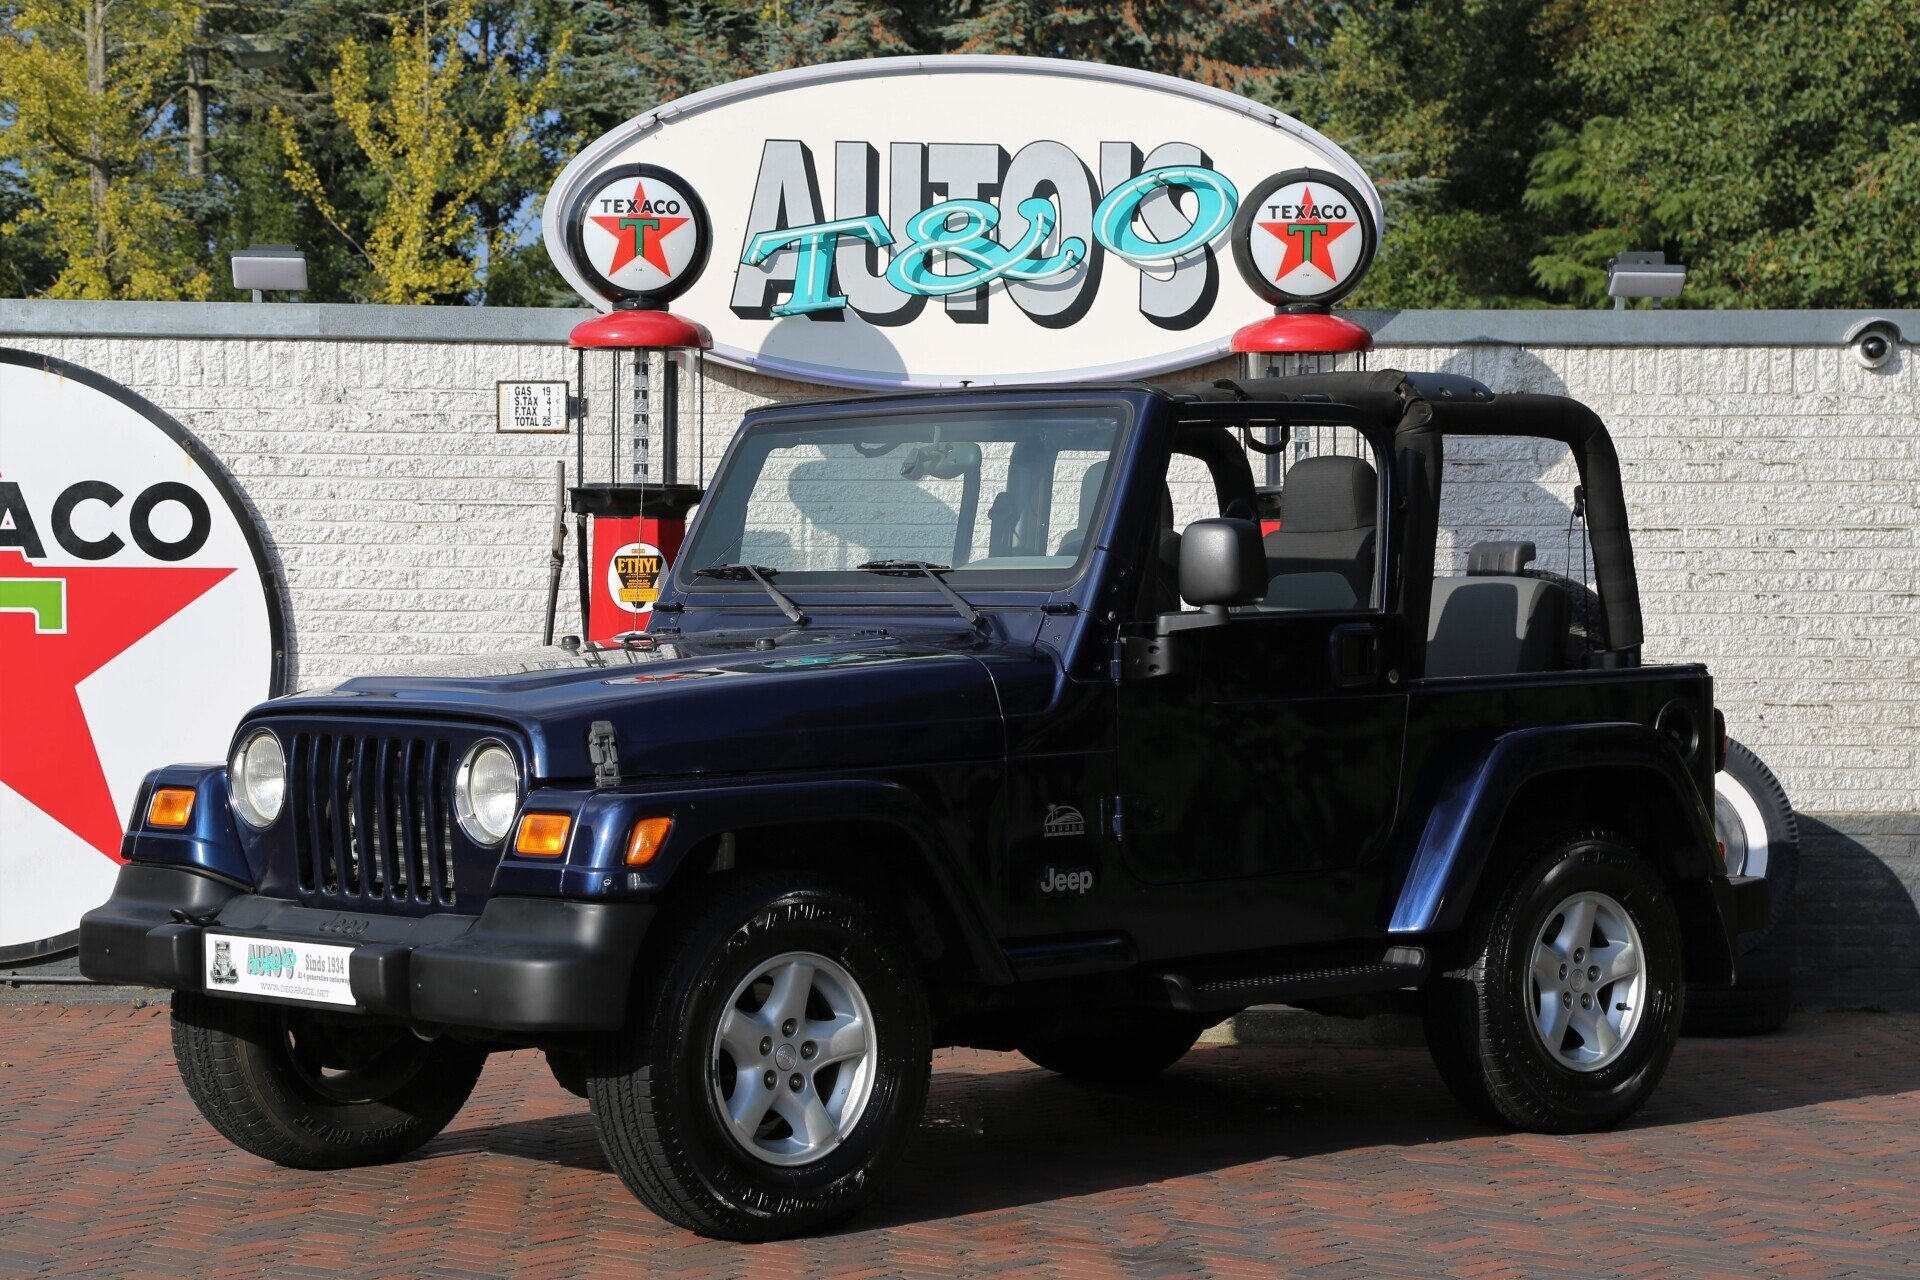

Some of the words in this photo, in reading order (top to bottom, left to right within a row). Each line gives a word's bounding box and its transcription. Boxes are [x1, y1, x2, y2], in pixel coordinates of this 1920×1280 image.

[600, 198, 681, 215] TEXACO
[1267, 204, 1347, 220] TEXACO
[729, 139, 1219, 331] AUTO'S
[740, 165, 1239, 318] T&O
[514, 386, 532, 396] GAS
[543, 386, 551, 396] 19
[514, 396, 539, 406] S.TAX
[546, 397, 552, 406] 4
[514, 407, 537, 416] F.TAX
[515, 417, 539, 427] TOTAL
[542, 417, 552, 427] 25
[617, 557, 660, 574] ETHYL
[1040, 868, 1093, 894] Jeep
[305, 954, 326, 973] Sinds
[328, 957, 345, 975] 1934
[260, 982, 330, 998] WWW.DEGARAGE.NET
